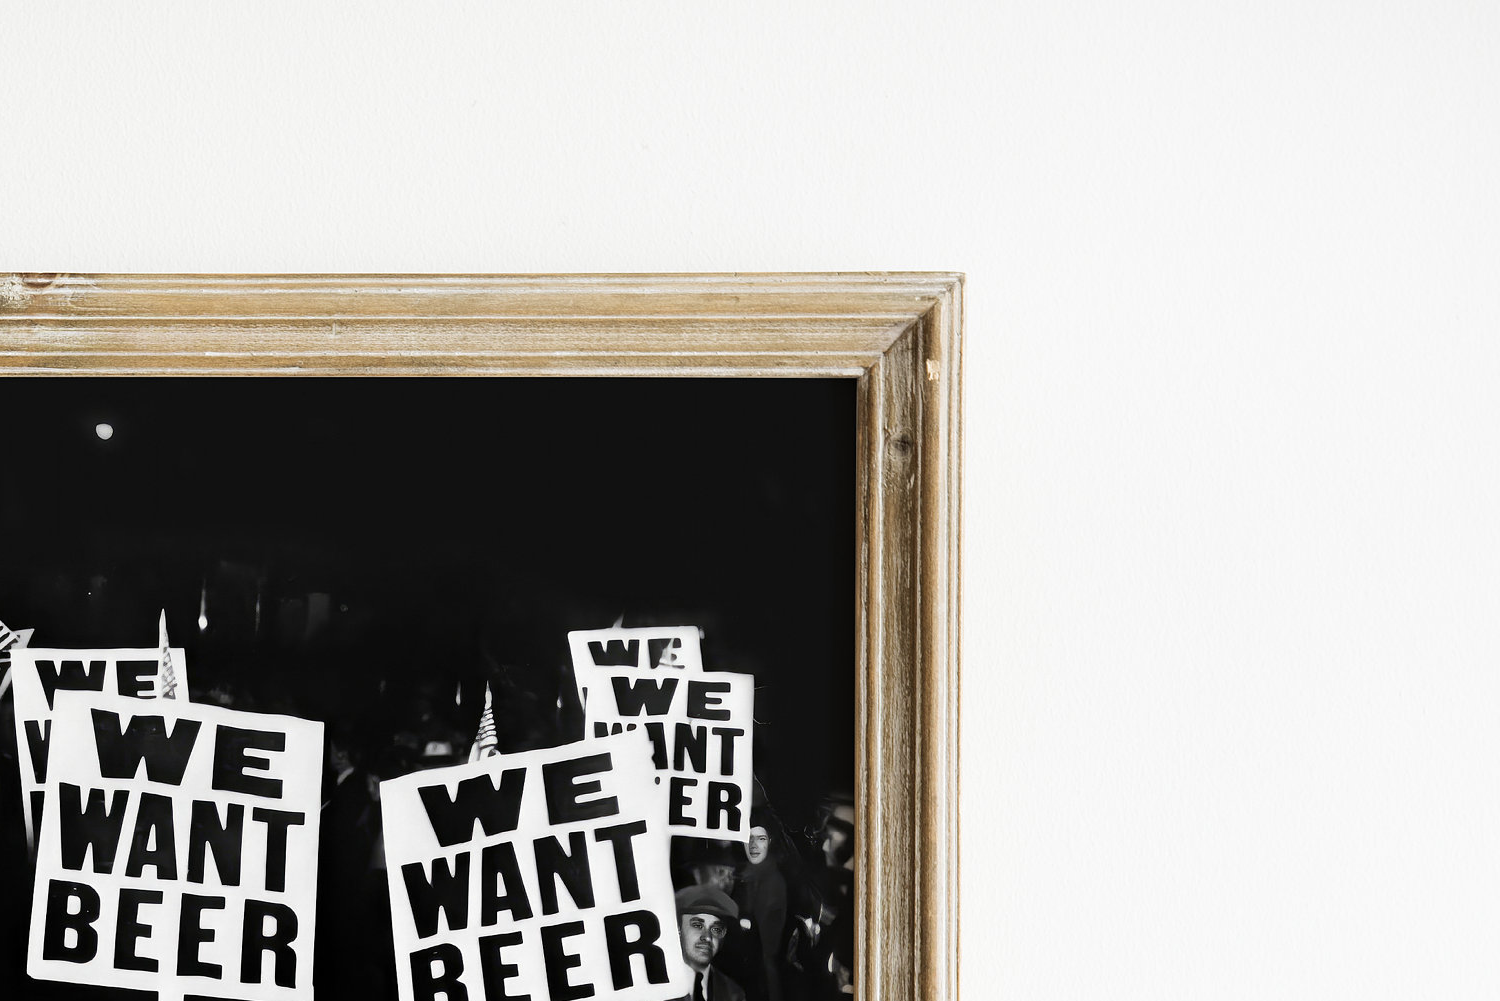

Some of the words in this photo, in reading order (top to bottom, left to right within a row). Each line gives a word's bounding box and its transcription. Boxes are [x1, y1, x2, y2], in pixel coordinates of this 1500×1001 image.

[587, 638, 685, 669] WE
[611, 676, 731, 721] WE
[90, 707, 287, 800] WE
[417, 752, 620, 848] WE
[59, 782, 306, 893] WANT
[668, 776, 743, 831] ER
[401, 820, 648, 940] WANT
[42, 878, 299, 989] BEER
